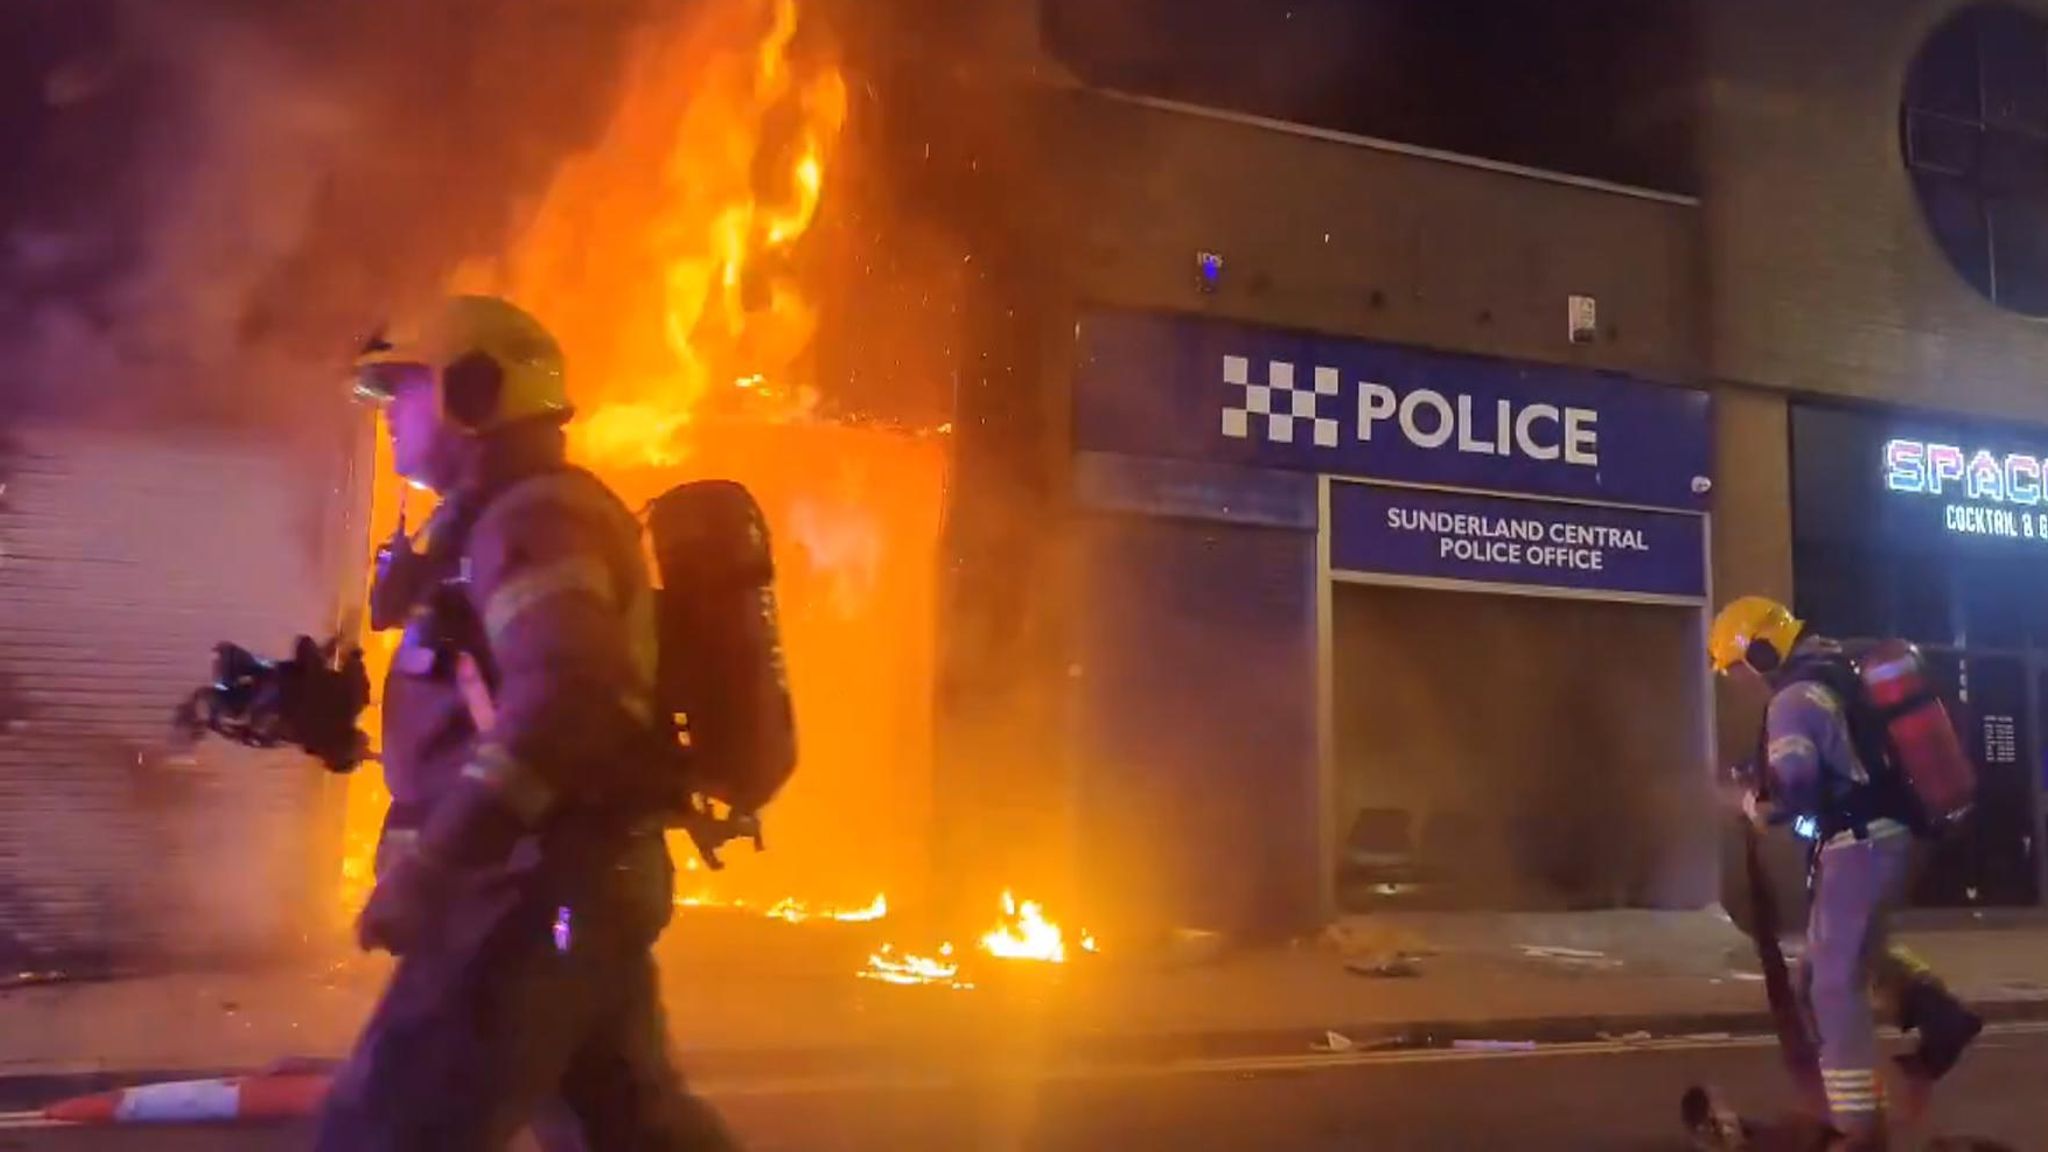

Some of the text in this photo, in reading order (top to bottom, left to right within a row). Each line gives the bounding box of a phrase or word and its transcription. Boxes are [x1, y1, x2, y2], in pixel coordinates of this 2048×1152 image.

[1357, 381, 1598, 466] POLICE
[1887, 439, 2048, 505] SPAC
[1387, 507, 1649, 550] SUNDERLAND CENTRAL
[1946, 504, 2018, 537] COCKTAIL
[2022, 513, 2034, 537] &
[1440, 537, 1603, 569] POLICE OFFICE
